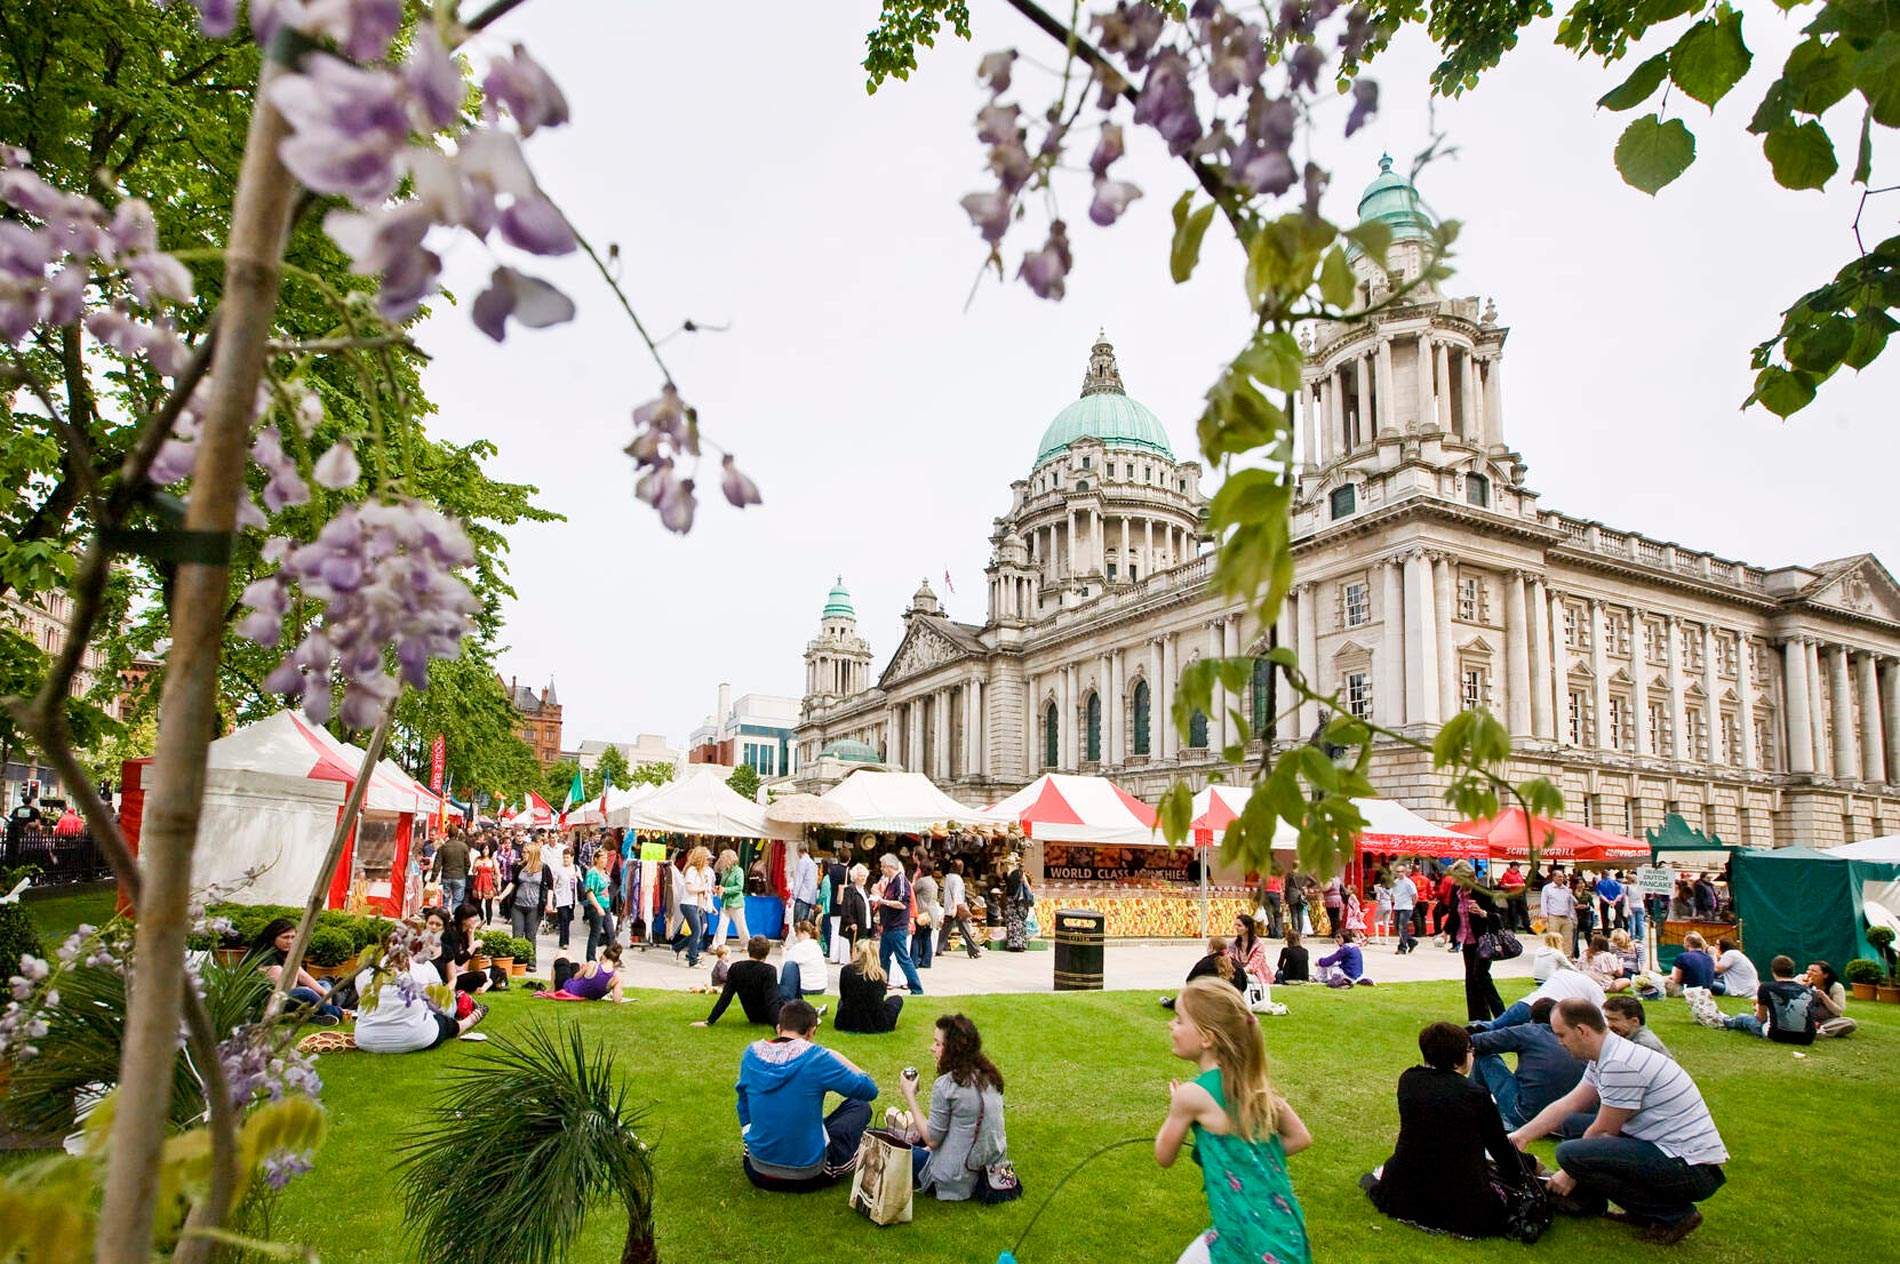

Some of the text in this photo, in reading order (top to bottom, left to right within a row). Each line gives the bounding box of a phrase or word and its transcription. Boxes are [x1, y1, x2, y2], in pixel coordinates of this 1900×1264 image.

[1050, 867, 1092, 879] WORLD
[1097, 868, 1129, 879] CLASS
[1639, 880, 1673, 889] PANCAKE
